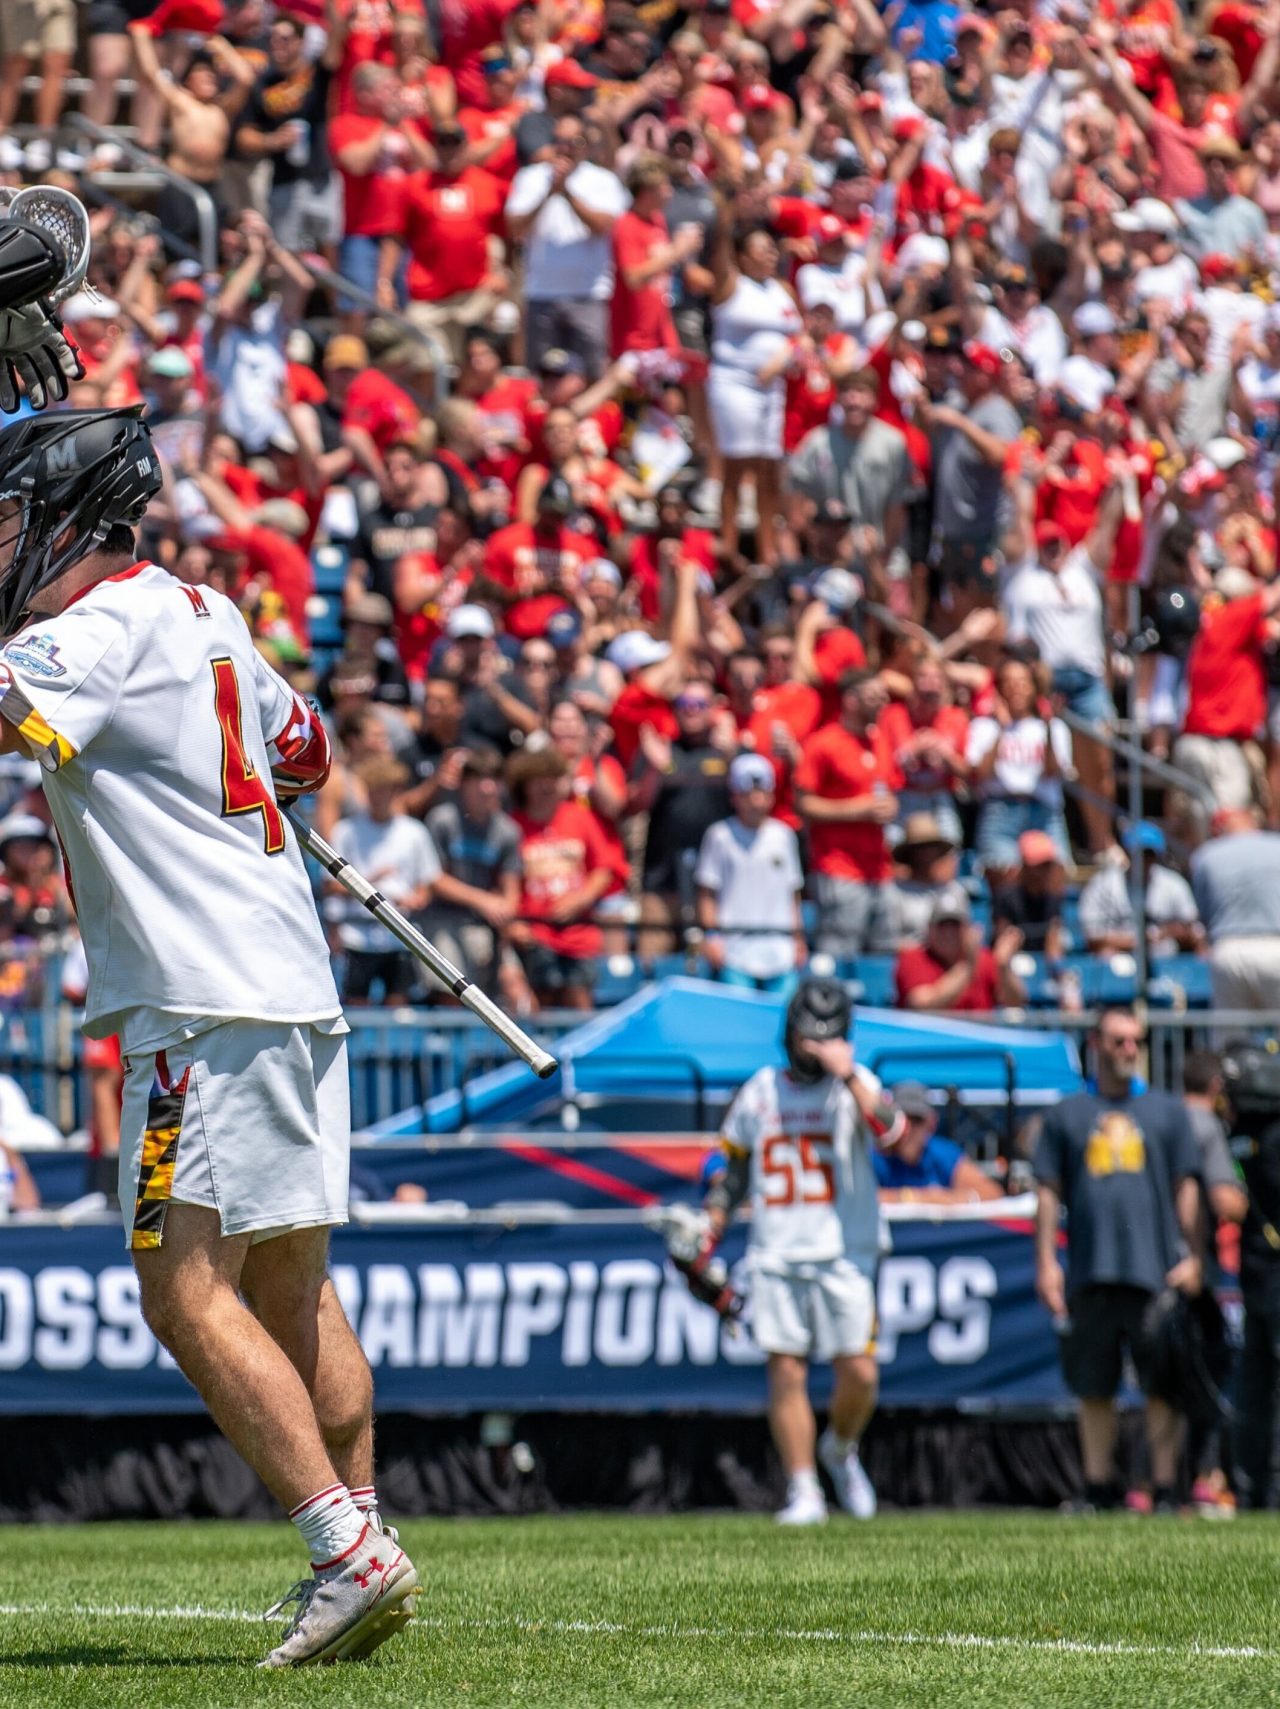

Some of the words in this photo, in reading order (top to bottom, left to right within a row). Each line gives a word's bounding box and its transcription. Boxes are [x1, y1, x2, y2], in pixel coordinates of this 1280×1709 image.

[46, 436, 83, 471] M
[136, 456, 152, 478] RM
[177, 586, 209, 613] M
[210, 656, 286, 855] 4
[763, 1132, 834, 1206] 55
